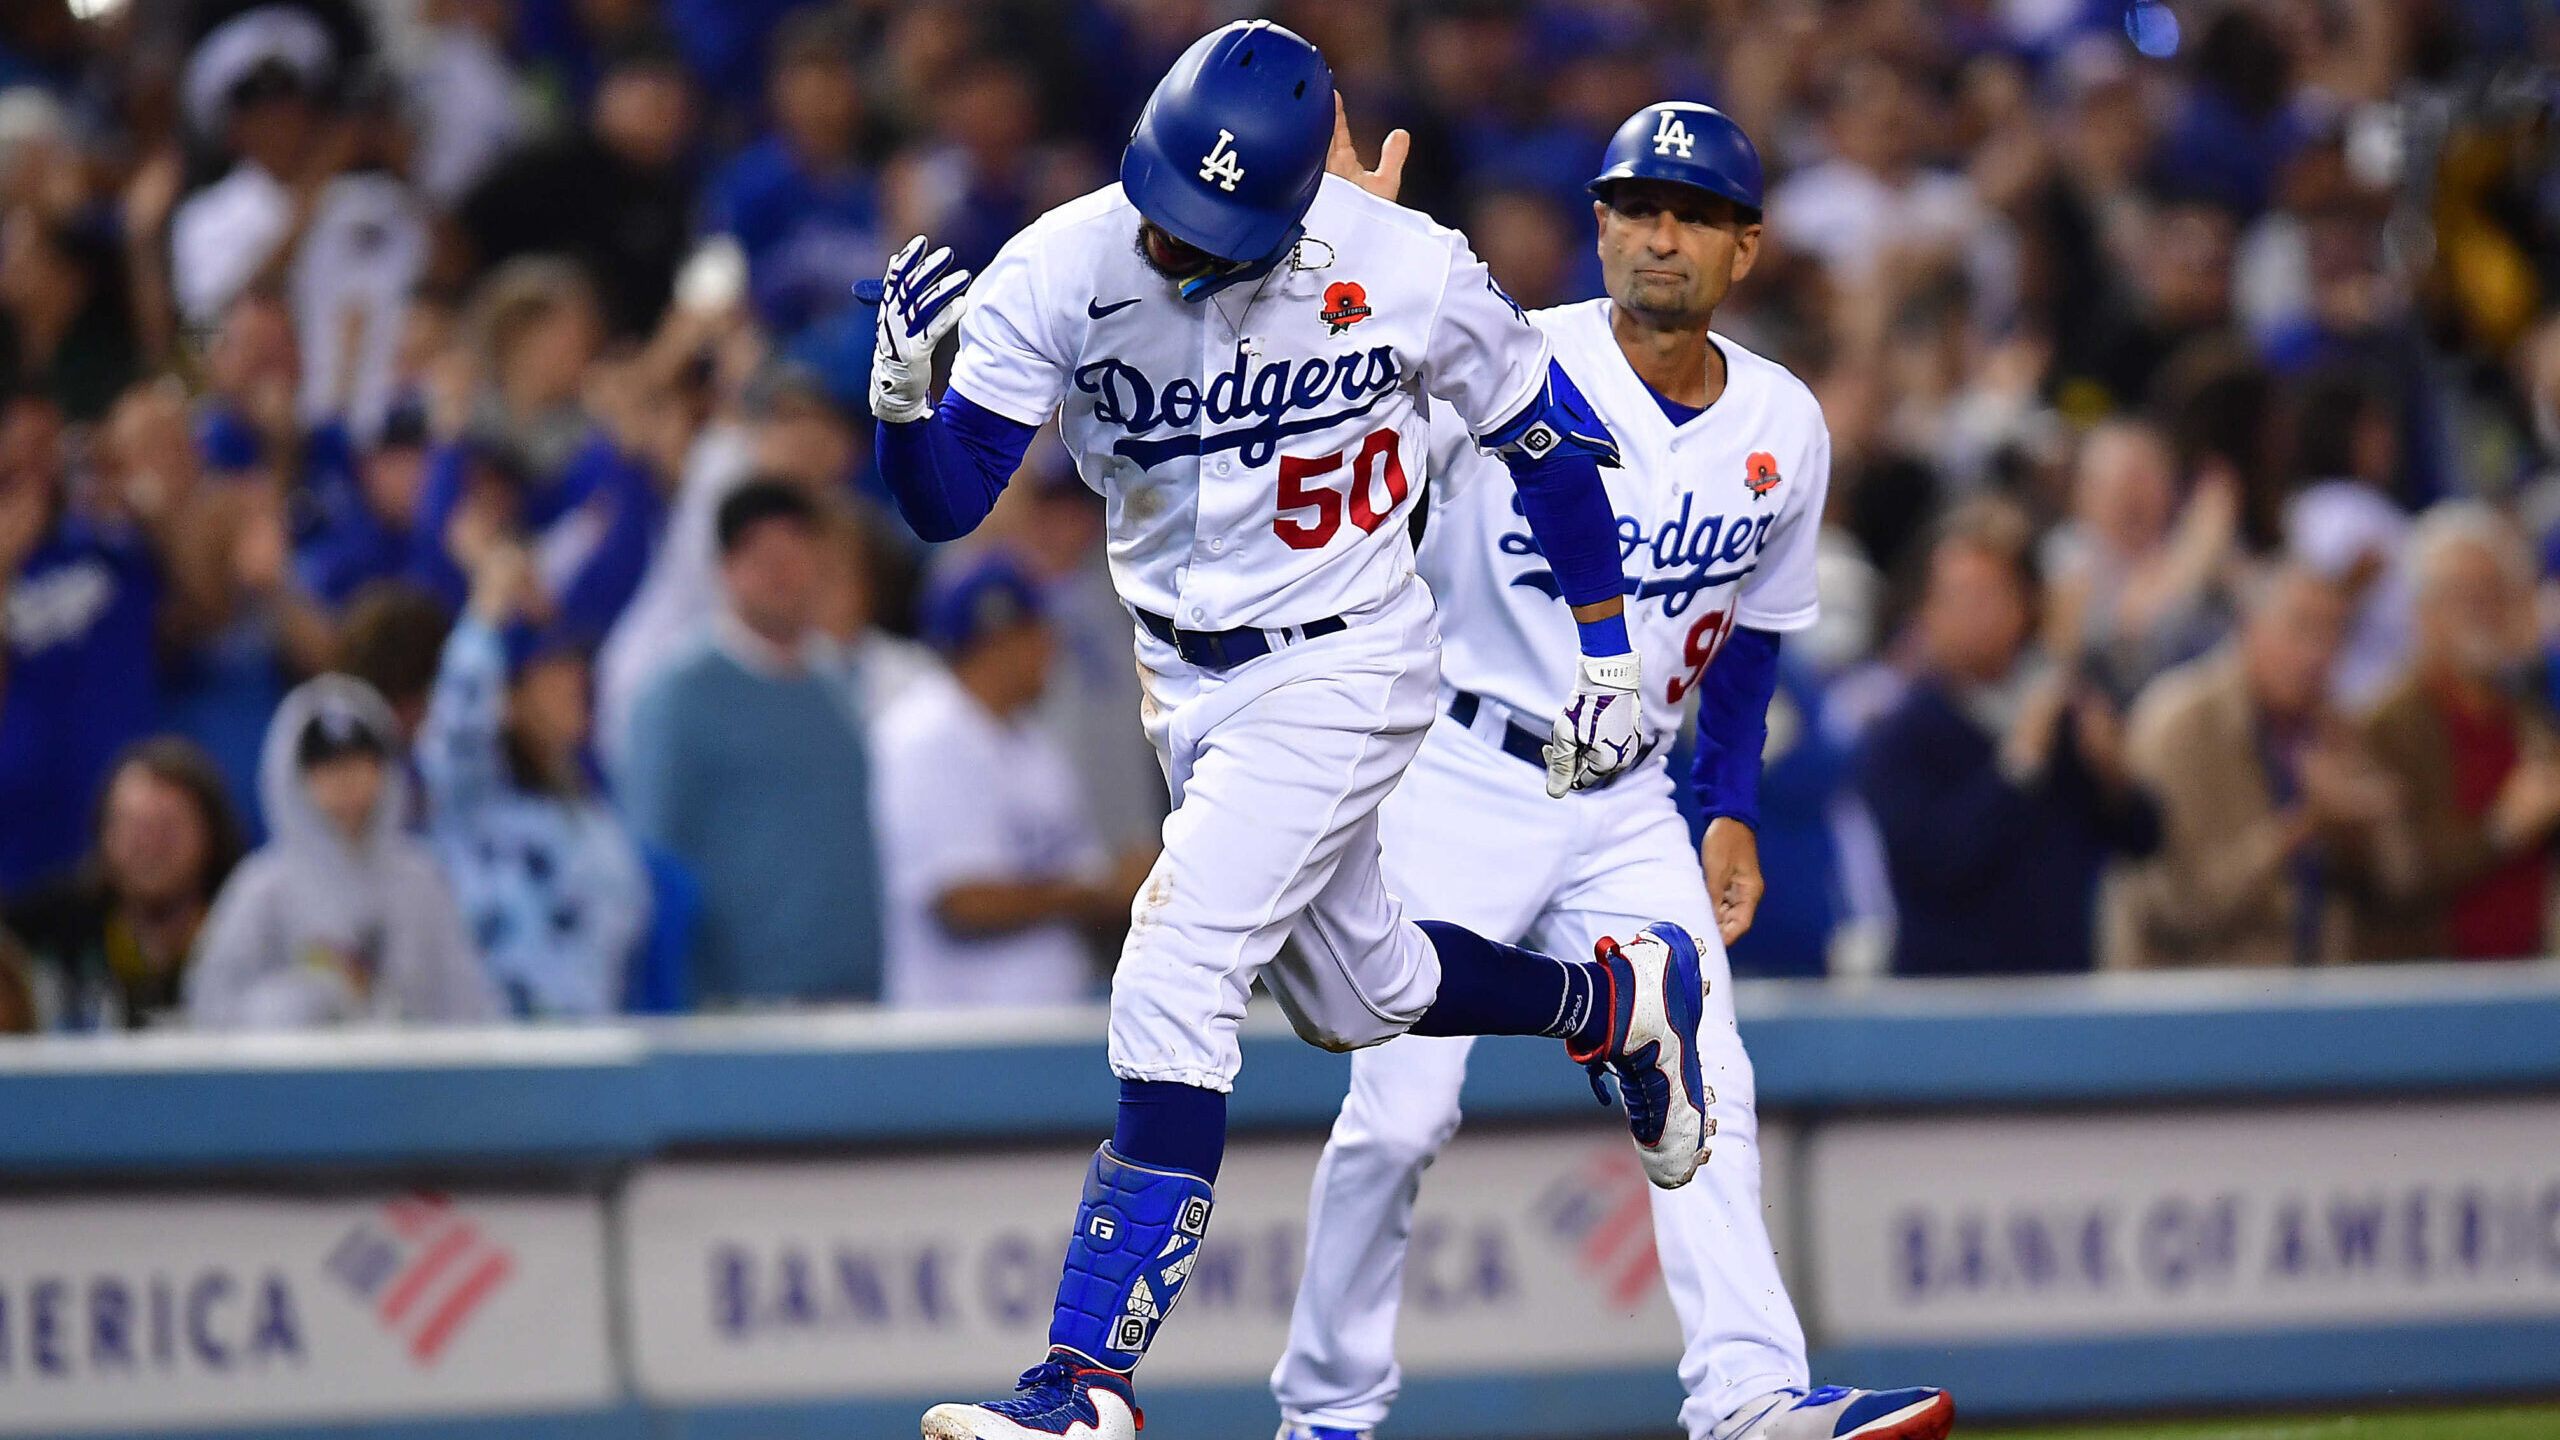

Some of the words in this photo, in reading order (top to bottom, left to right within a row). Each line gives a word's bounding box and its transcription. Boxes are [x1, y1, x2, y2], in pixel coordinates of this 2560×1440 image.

[1199, 129, 1244, 191] LA
[1653, 109, 1695, 158] LA
[1074, 338, 1400, 468] Dodgers
[1273, 427, 1408, 549] 50
[1498, 491, 1775, 617] odger
[1667, 595, 1738, 704] 9
[710, 1240, 965, 1338] BANK
[1893, 1202, 2117, 1300] BANK
[2138, 1195, 2240, 1292] OF
[0, 1265, 310, 1380] ERICA
